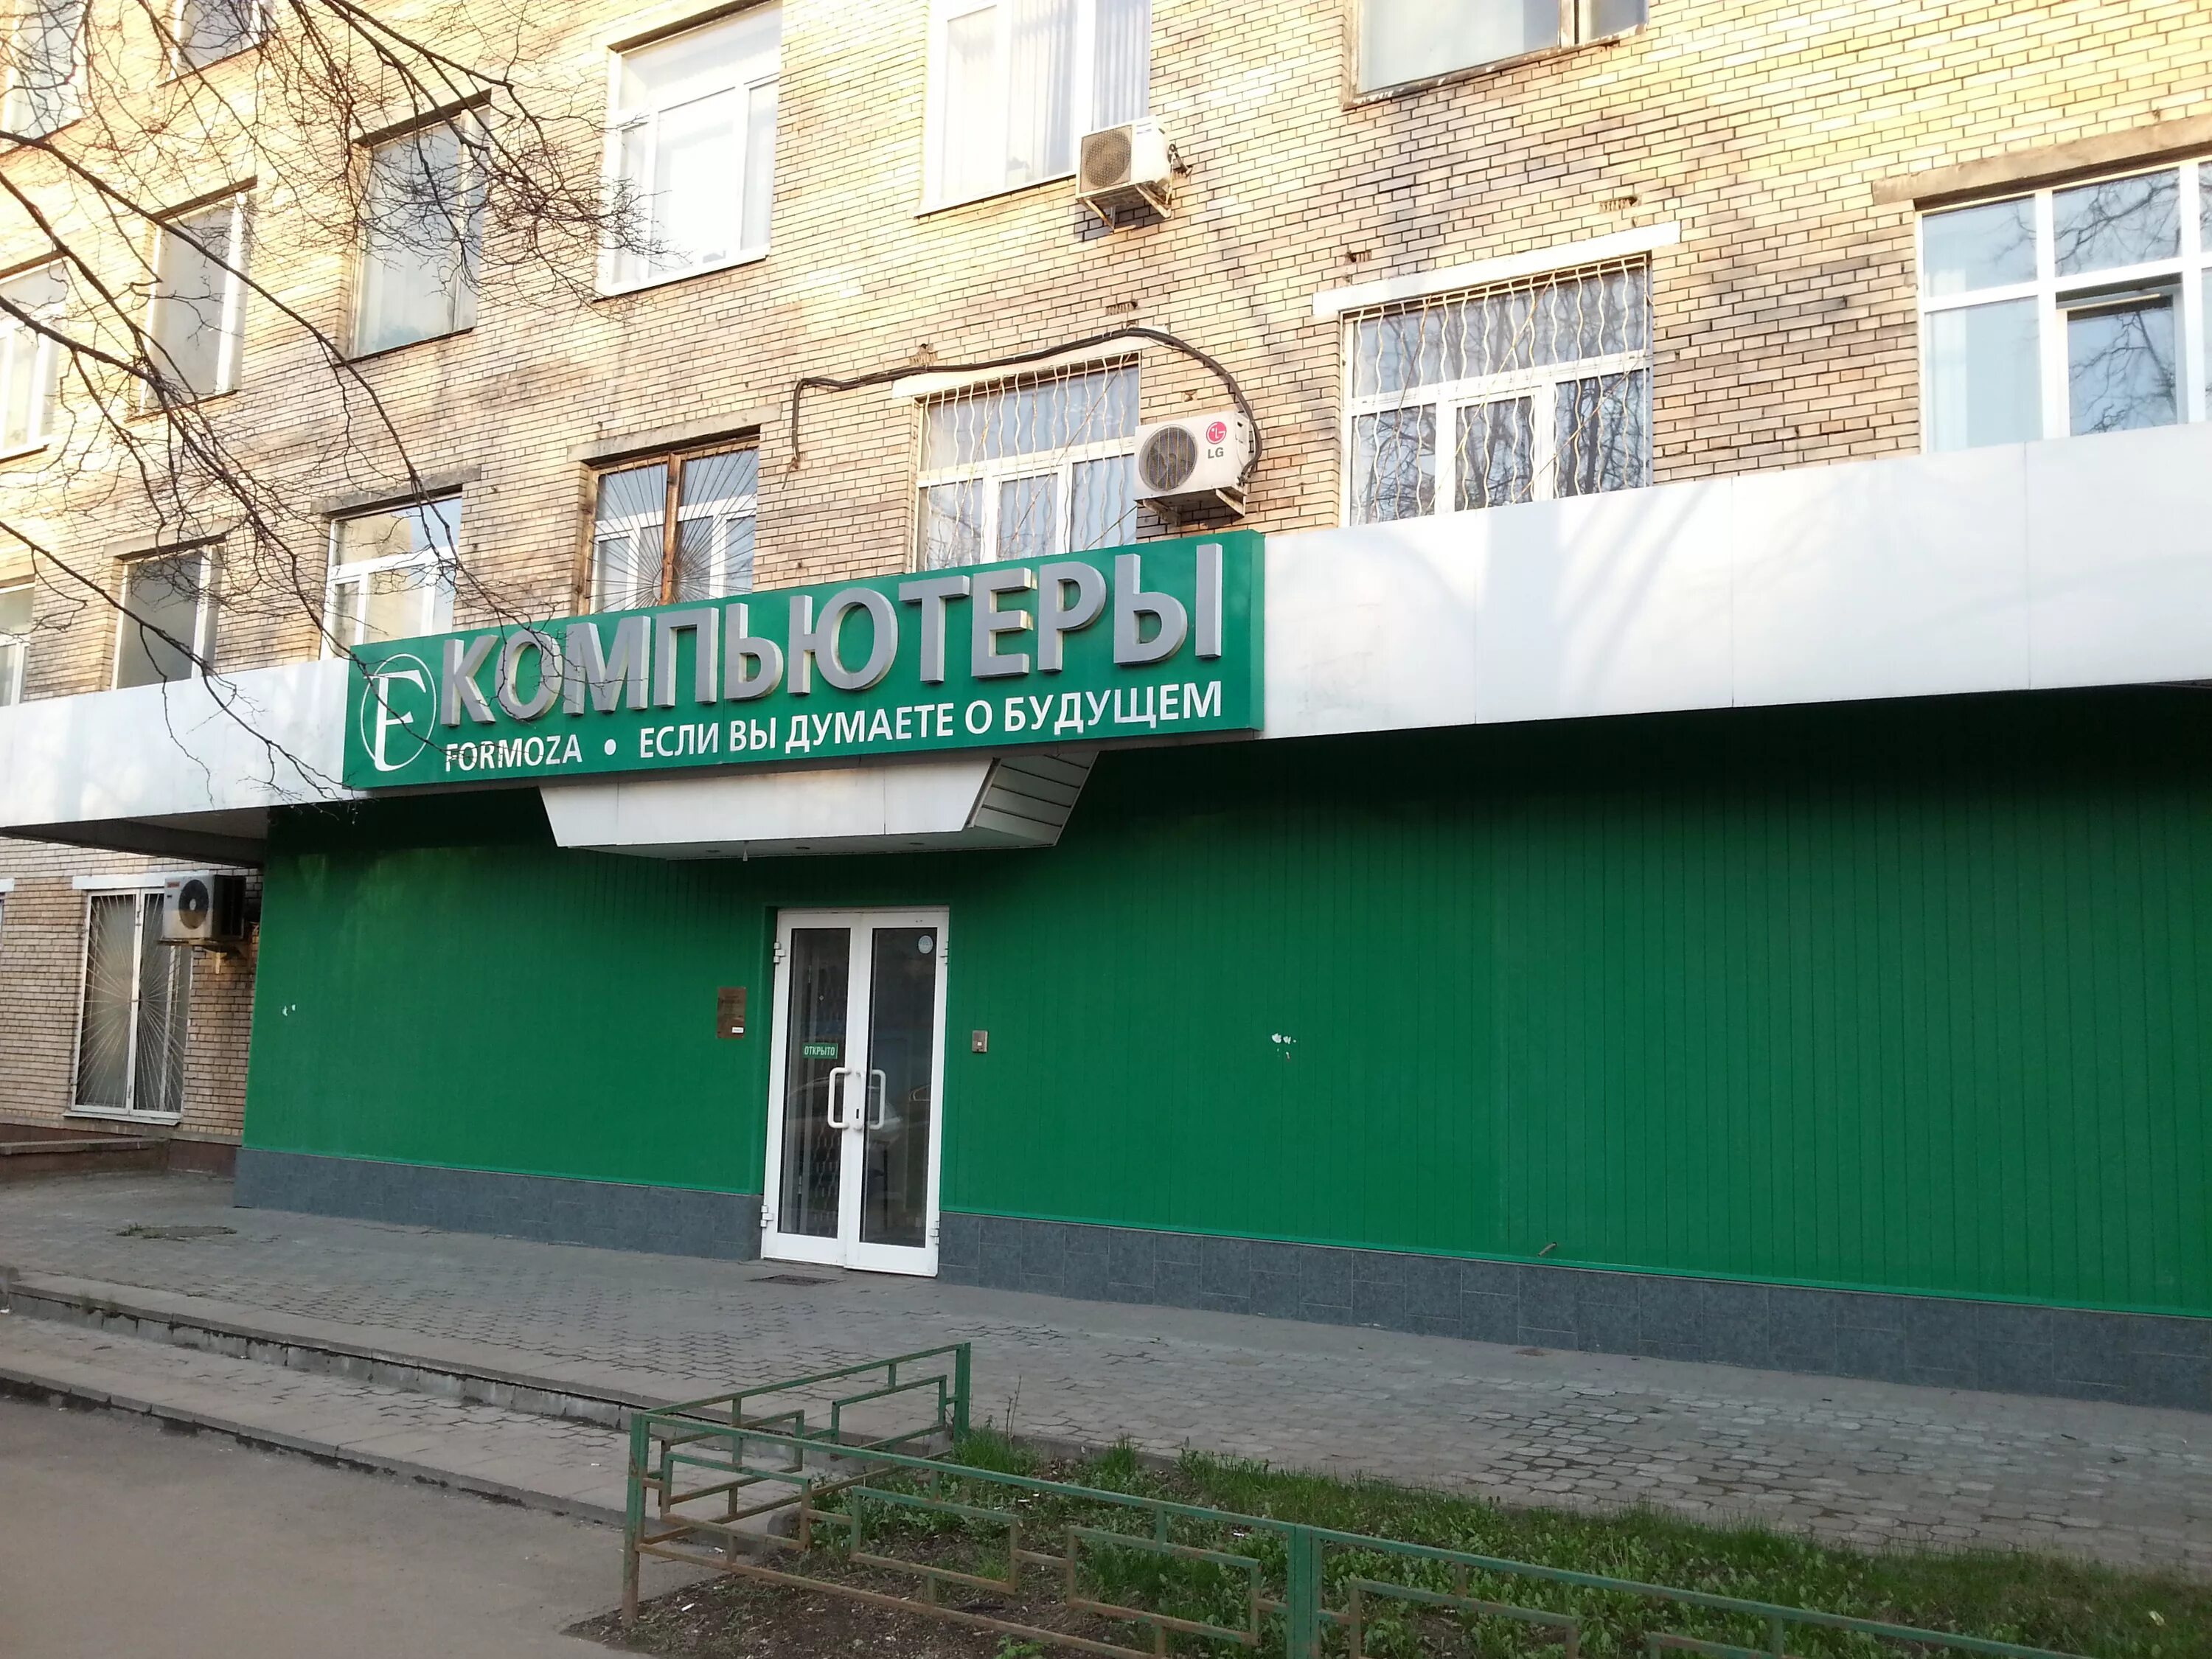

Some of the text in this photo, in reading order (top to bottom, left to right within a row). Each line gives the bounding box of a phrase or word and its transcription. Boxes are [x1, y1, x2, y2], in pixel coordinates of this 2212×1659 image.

[1207, 447, 1224, 459] LG
[440, 543, 1222, 726] КОМПЬЮТЕРЫ
[640, 681, 1221, 758] ЕСЛИ ВЫ ДУМАЕТЕ О БУДУЩЕМ
[445, 734, 582, 772] FORMOZA
[804, 1046, 835, 1056] ОТКРЫТО
